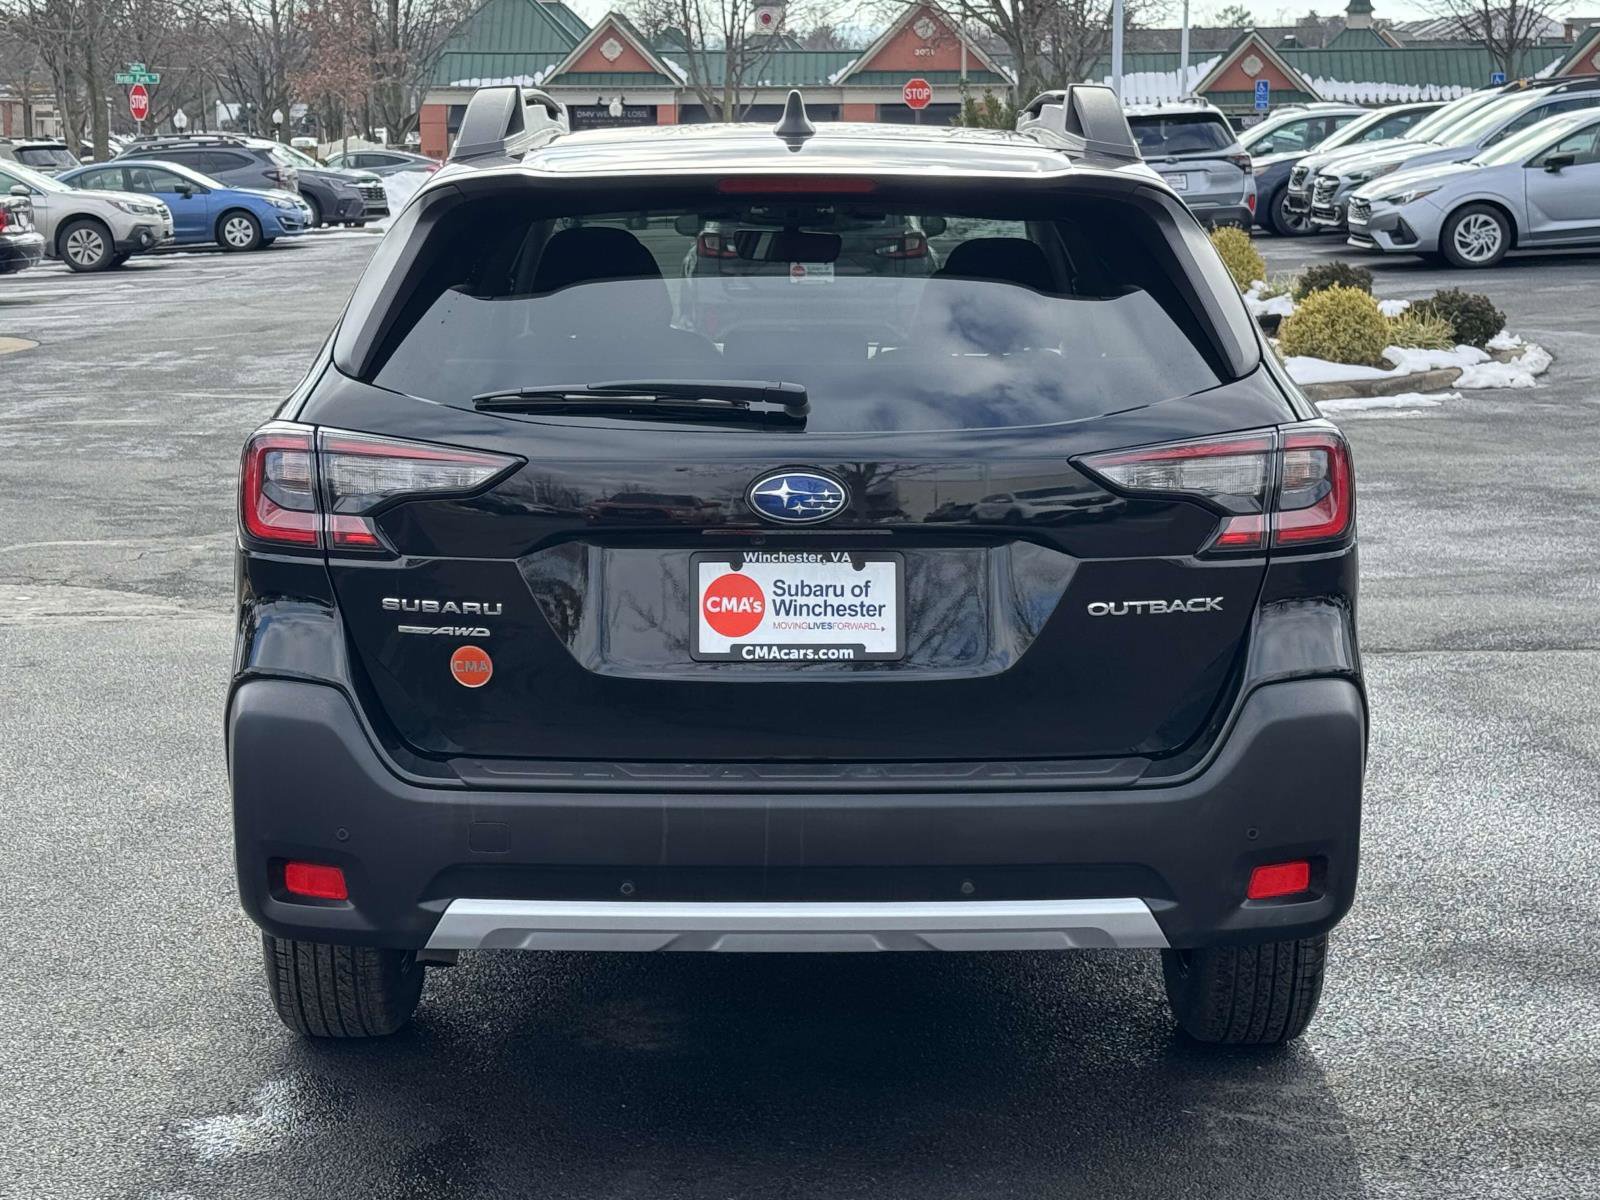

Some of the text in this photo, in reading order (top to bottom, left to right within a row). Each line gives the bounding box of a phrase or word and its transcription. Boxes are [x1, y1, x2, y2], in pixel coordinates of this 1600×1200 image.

[905, 88, 930, 100] STOP
[131, 95, 147, 109] STOP
[743, 552, 852, 565] Winchester, VA
[772, 579, 872, 598] Subaru of
[382, 597, 503, 616] SUBARU
[706, 597, 763, 613] CMA's
[772, 599, 887, 617] Winchester
[1087, 597, 1224, 616] OUTBACK
[432, 626, 491, 637] AWD
[741, 646, 855, 660] CMAcars.com
[453, 660, 490, 673] CMA
